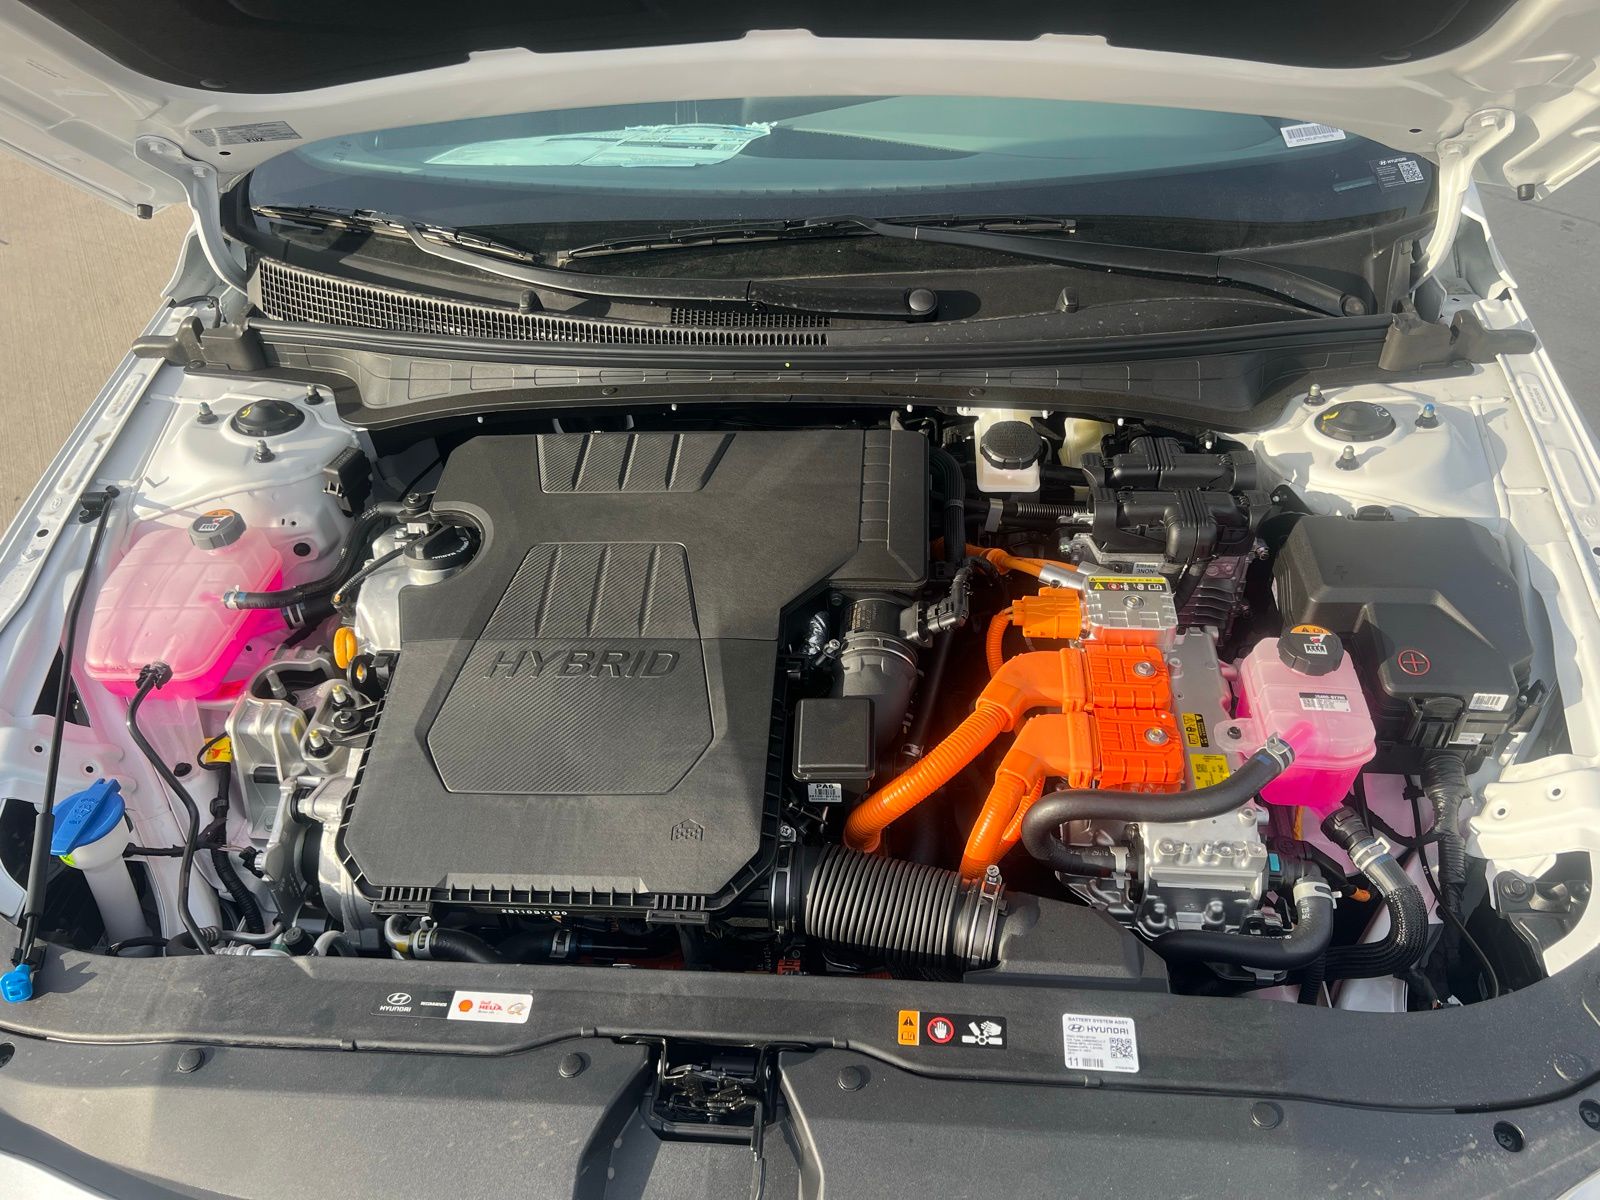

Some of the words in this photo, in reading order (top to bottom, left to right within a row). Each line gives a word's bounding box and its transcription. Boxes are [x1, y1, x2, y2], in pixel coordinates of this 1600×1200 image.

[483, 649, 680, 678] HYBRID
[479, 1003, 503, 1011] HELIX
[1087, 1026, 1129, 1035] HYUNDAI
[1068, 1056, 1079, 1067] 11
